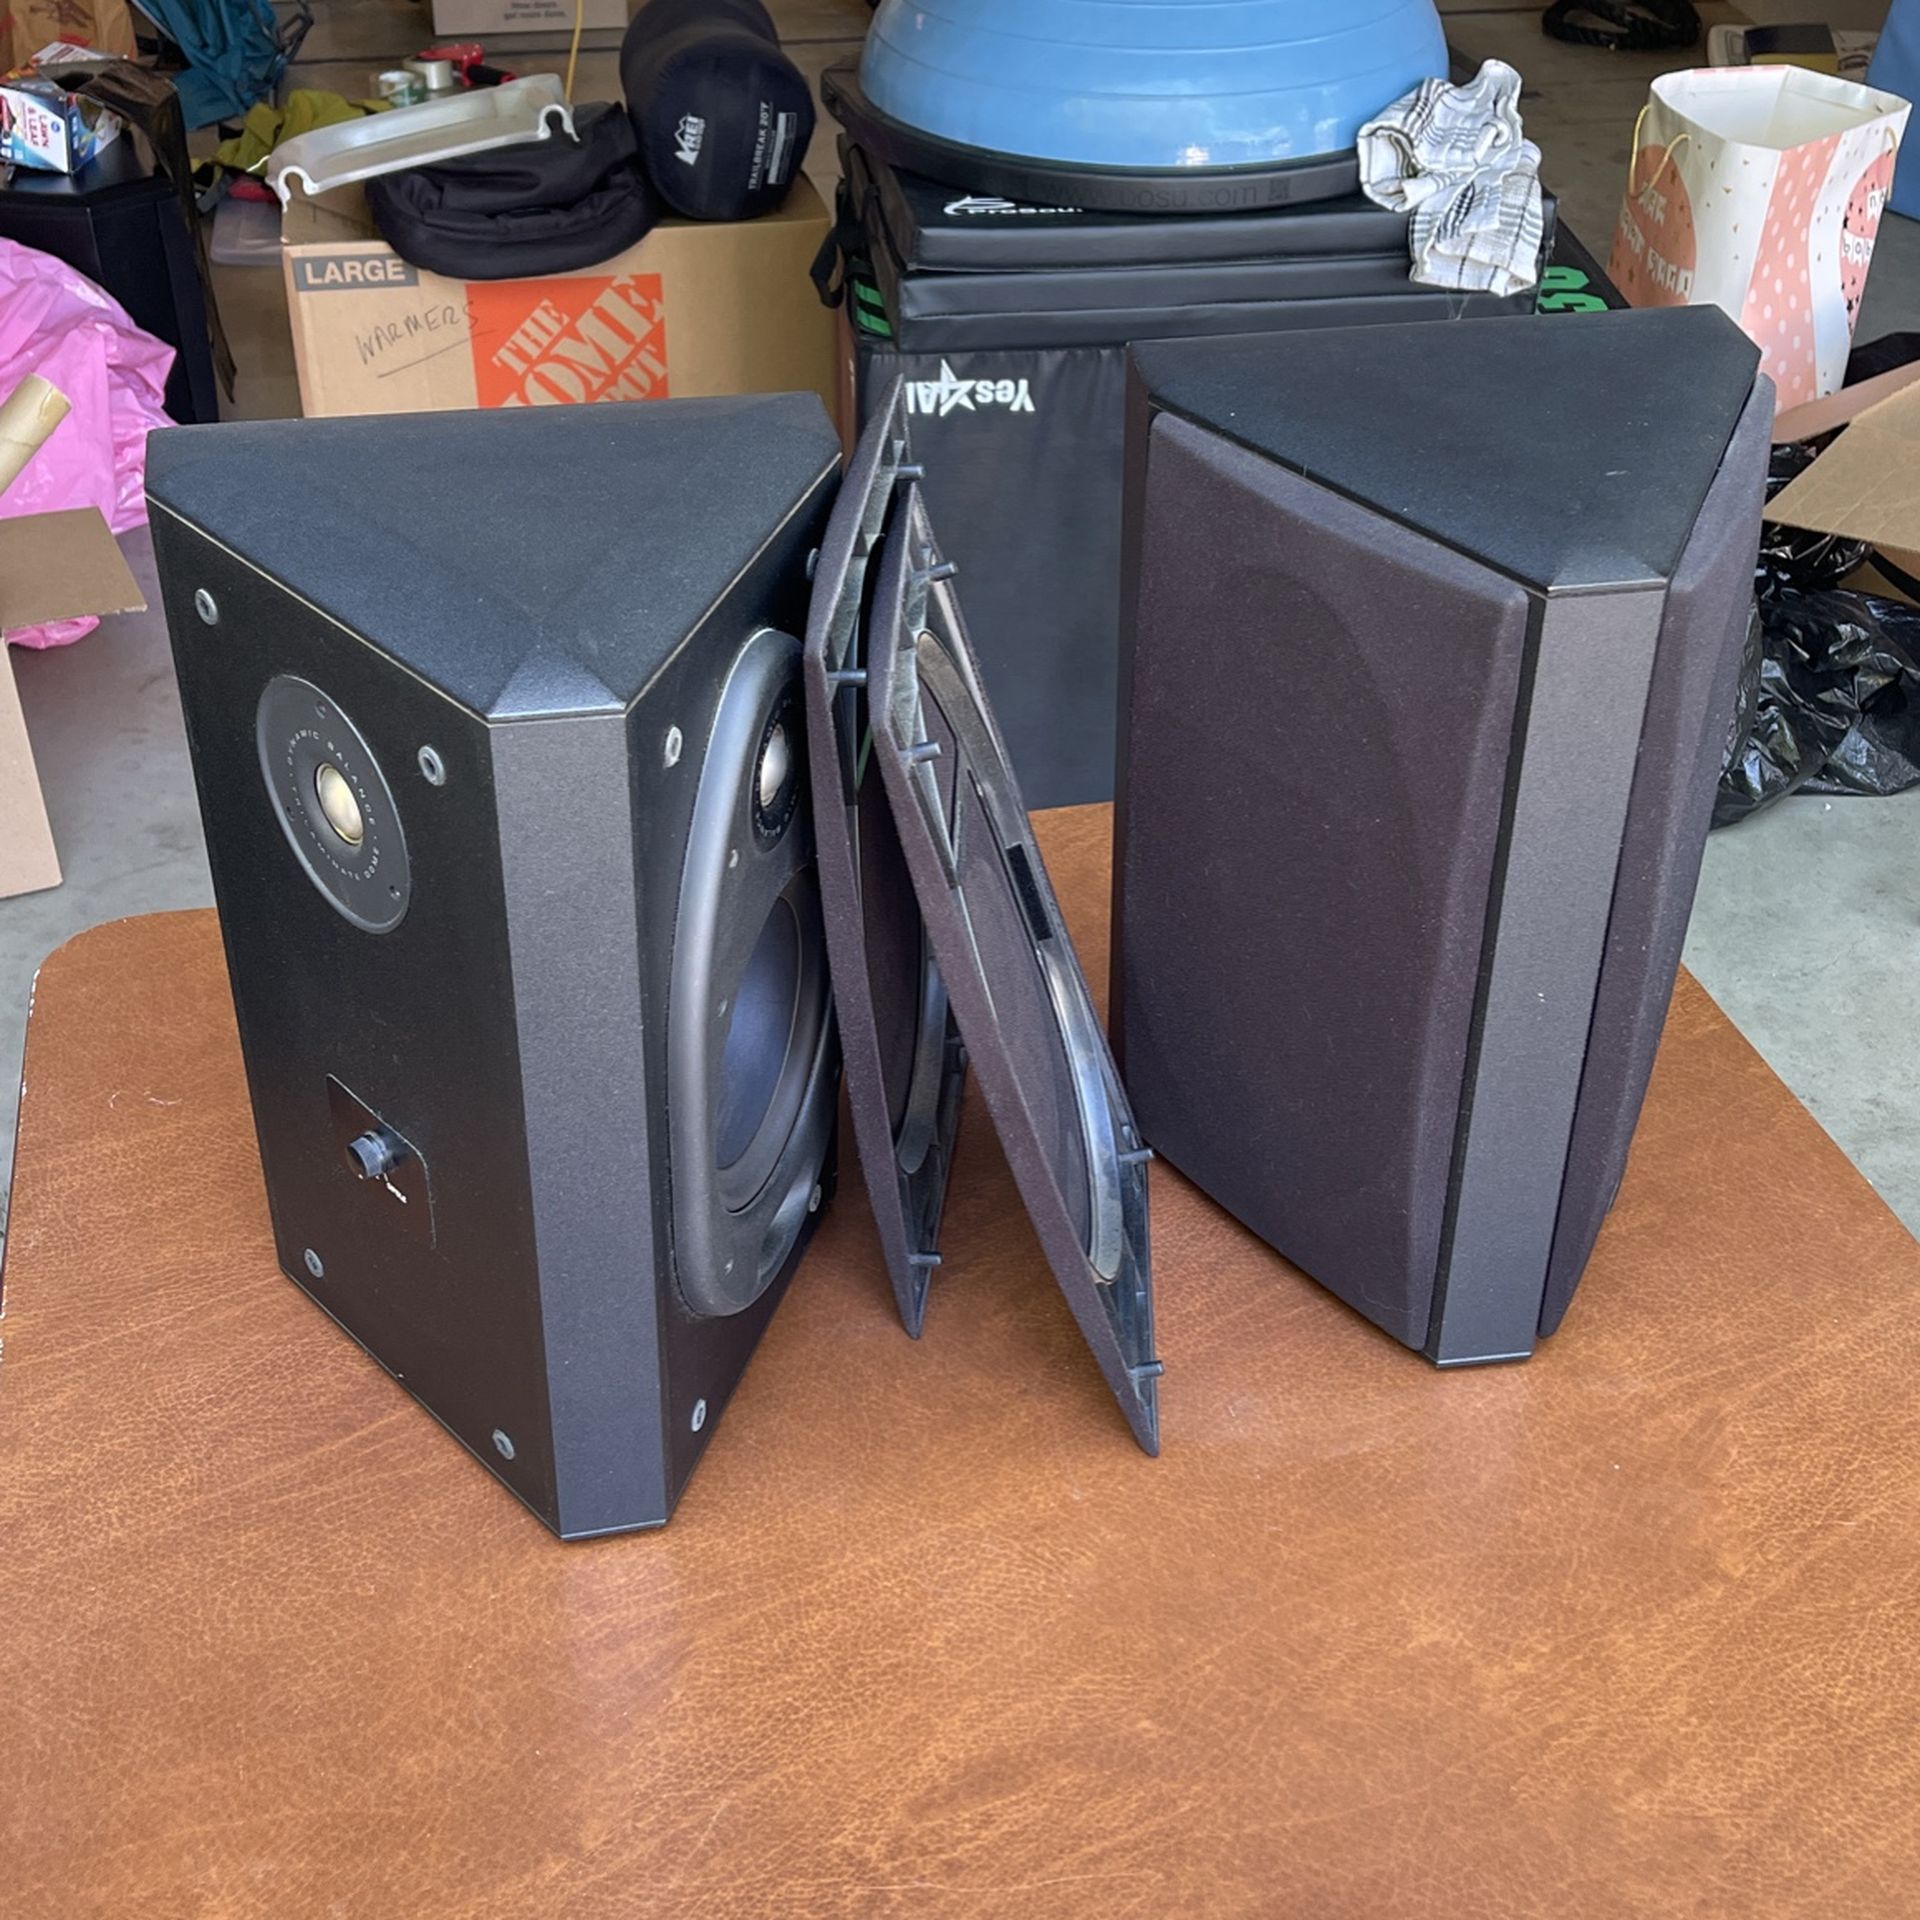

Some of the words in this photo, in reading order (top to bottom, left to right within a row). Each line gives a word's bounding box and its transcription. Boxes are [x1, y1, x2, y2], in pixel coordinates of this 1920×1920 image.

[748, 129, 768, 190] TRAILBREAK
[305, 259, 406, 285] LARGE
[355, 300, 479, 365] WARMERS
[491, 298, 571, 376] THE
[500, 274, 666, 407] OME
[287, 729, 320, 765] DYNAMIC
[327, 741, 376, 825] BALANCE
[364, 846, 380, 880] DOME
